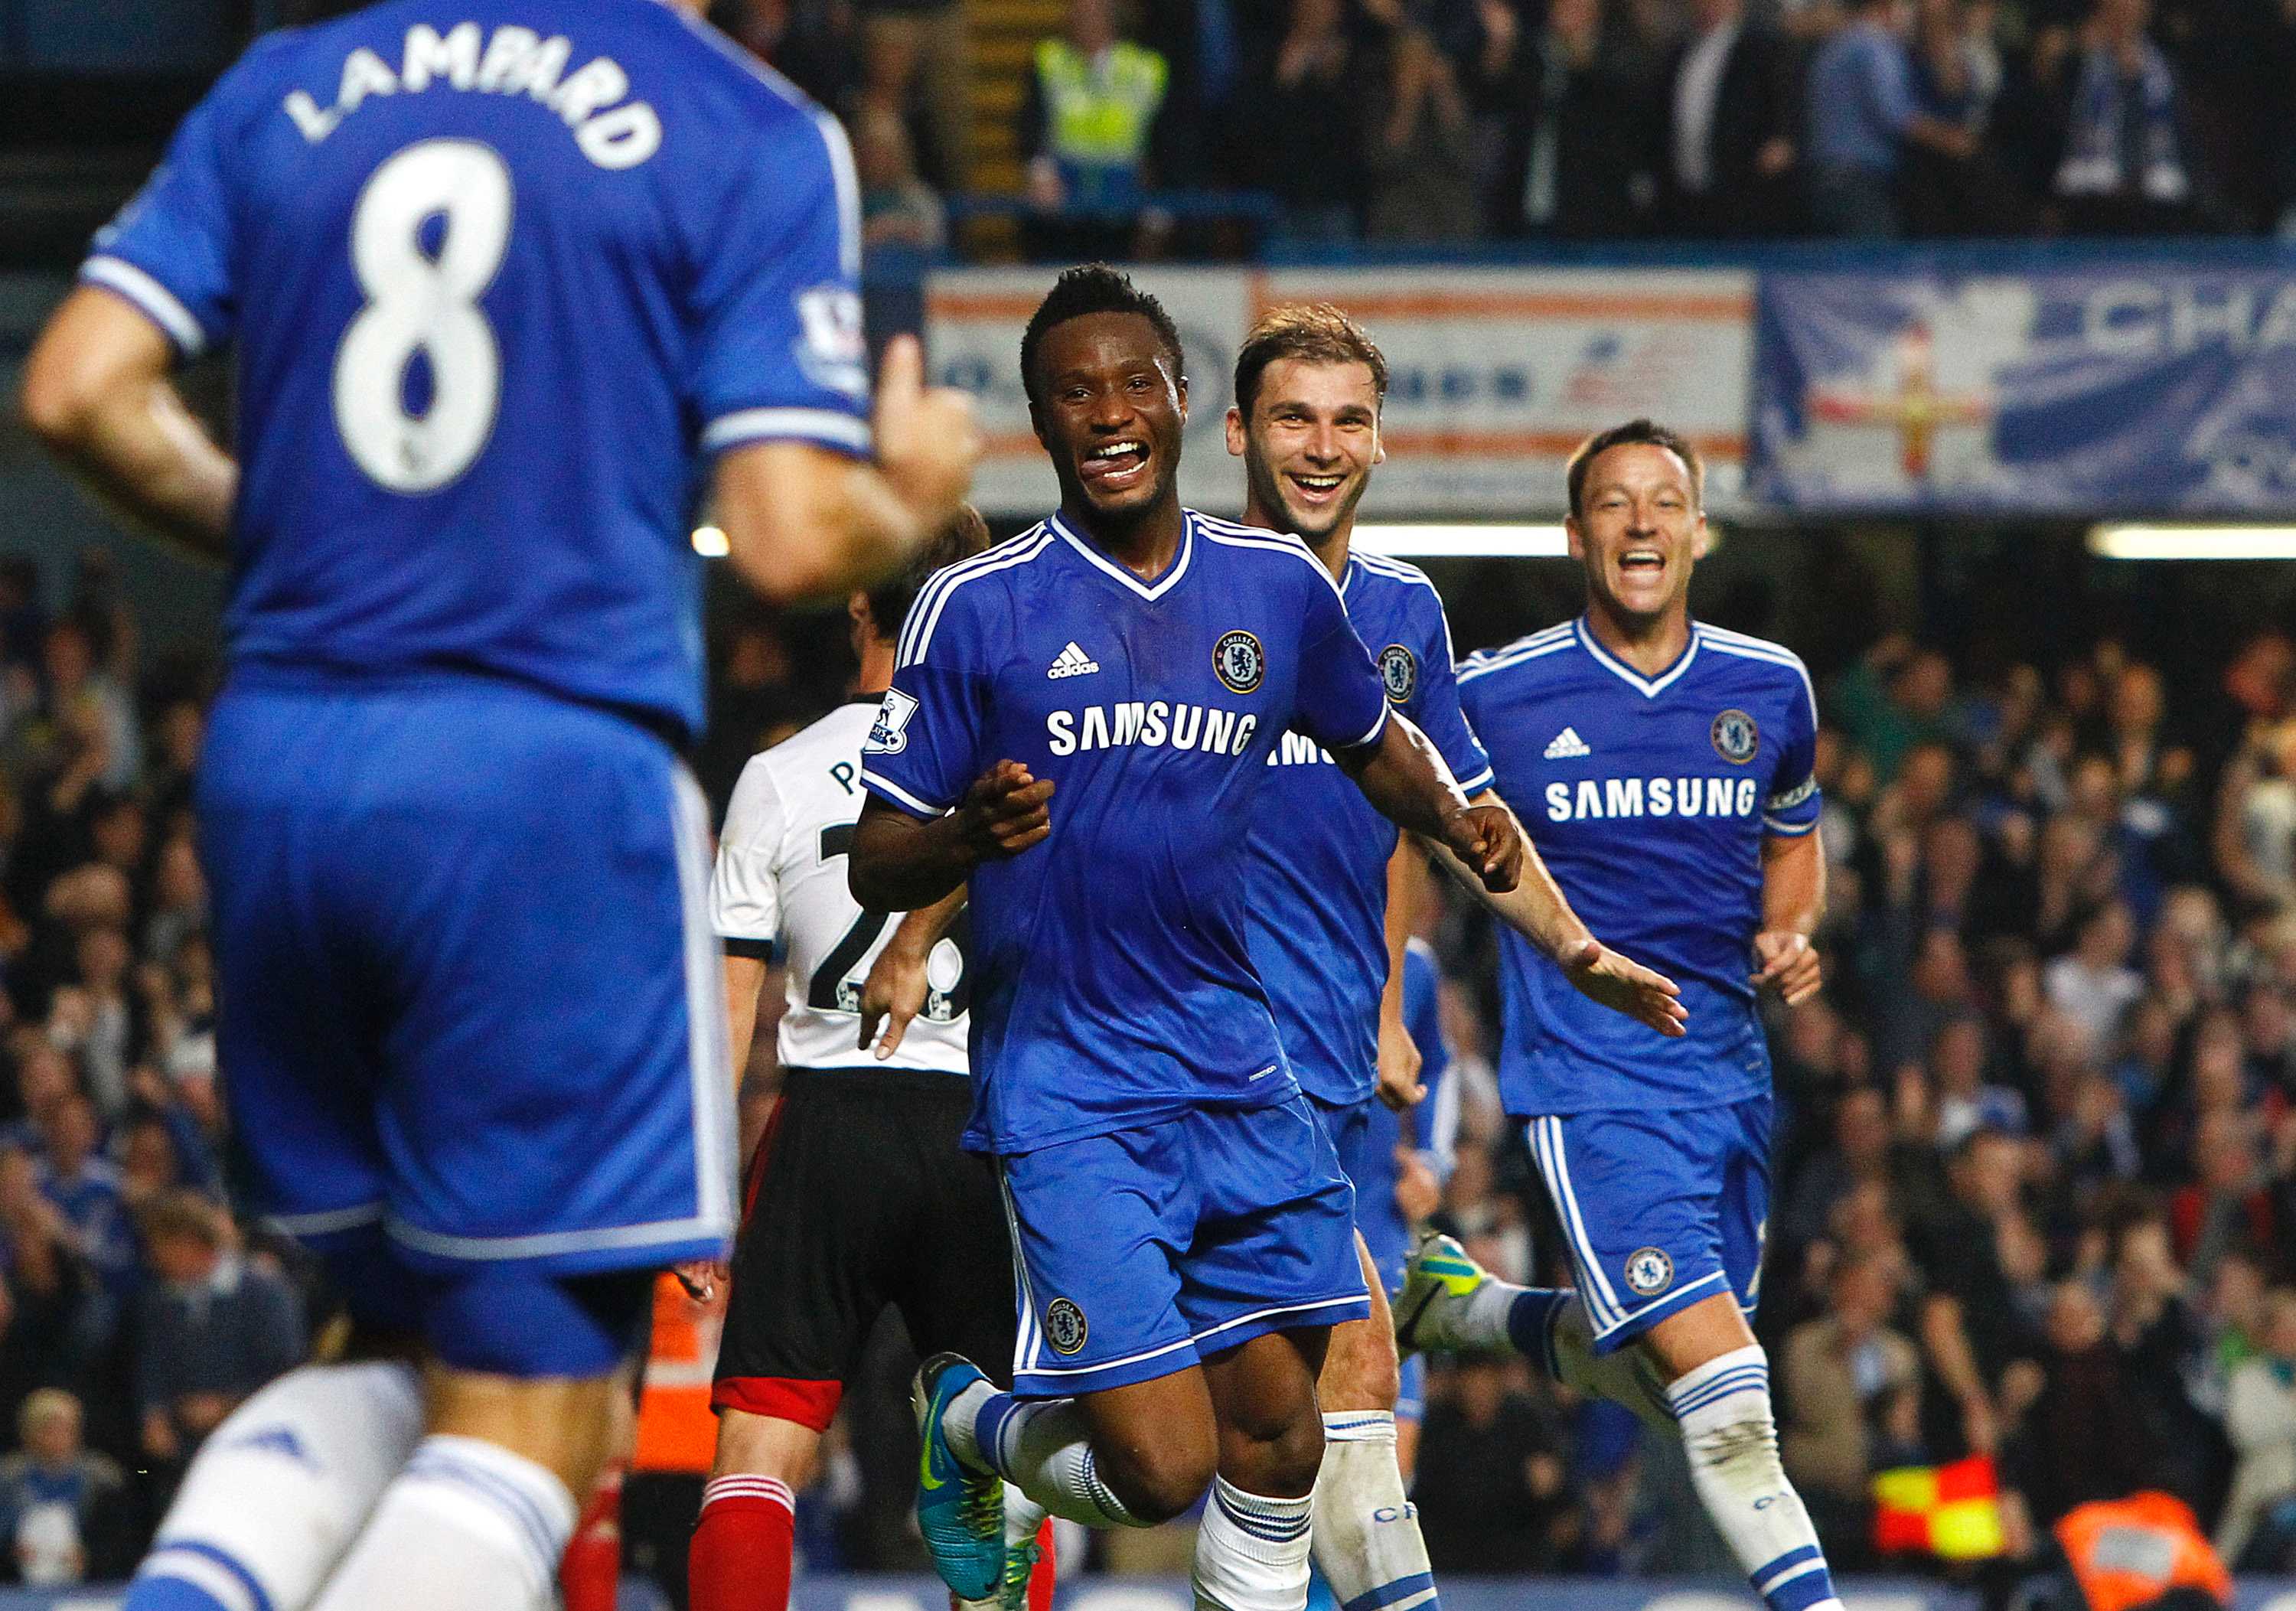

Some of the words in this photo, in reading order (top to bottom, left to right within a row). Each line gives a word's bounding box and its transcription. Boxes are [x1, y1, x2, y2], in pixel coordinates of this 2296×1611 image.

[284, 21, 663, 170] LAMPARD
[331, 136, 514, 494] 8
[1047, 661, 1100, 680] adidas
[1047, 700, 1257, 756] SAMSUNG
[1545, 777, 1757, 822] SAMSUNG
